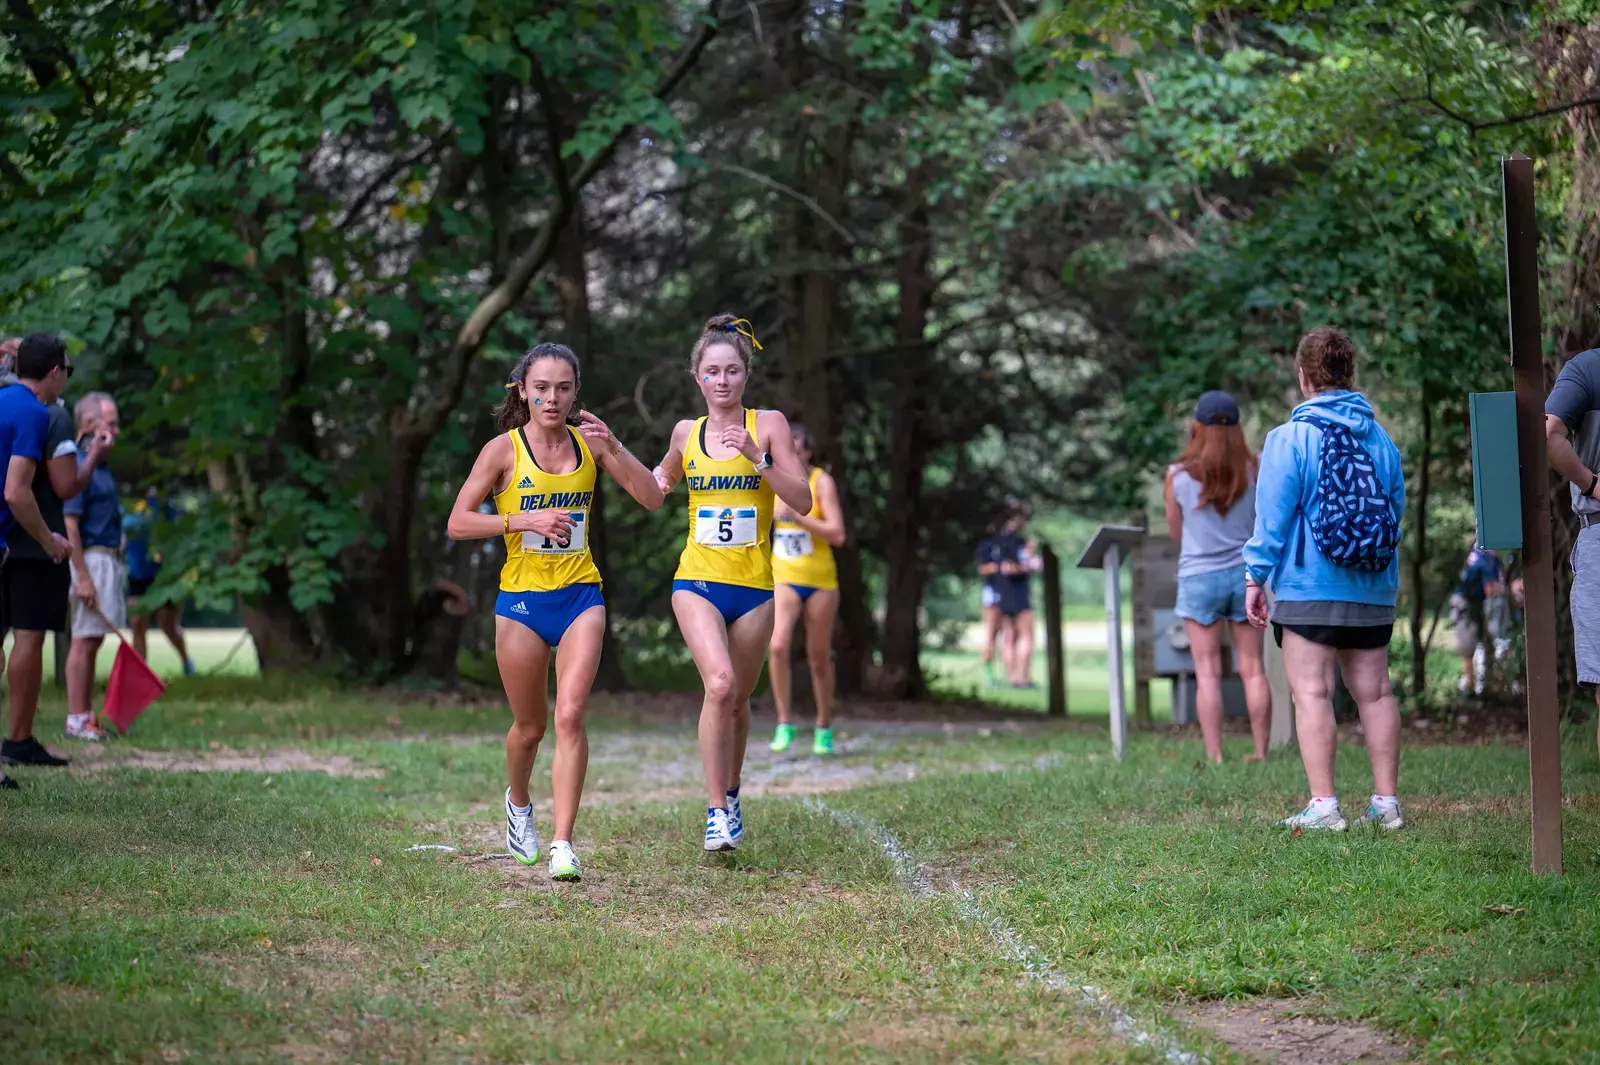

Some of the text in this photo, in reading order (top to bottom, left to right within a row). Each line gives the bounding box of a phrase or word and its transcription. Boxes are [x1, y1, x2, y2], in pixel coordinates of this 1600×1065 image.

[688, 475, 762, 491] DELAWARE
[519, 491, 593, 511] DELAWAR
[718, 521, 733, 542] 5
